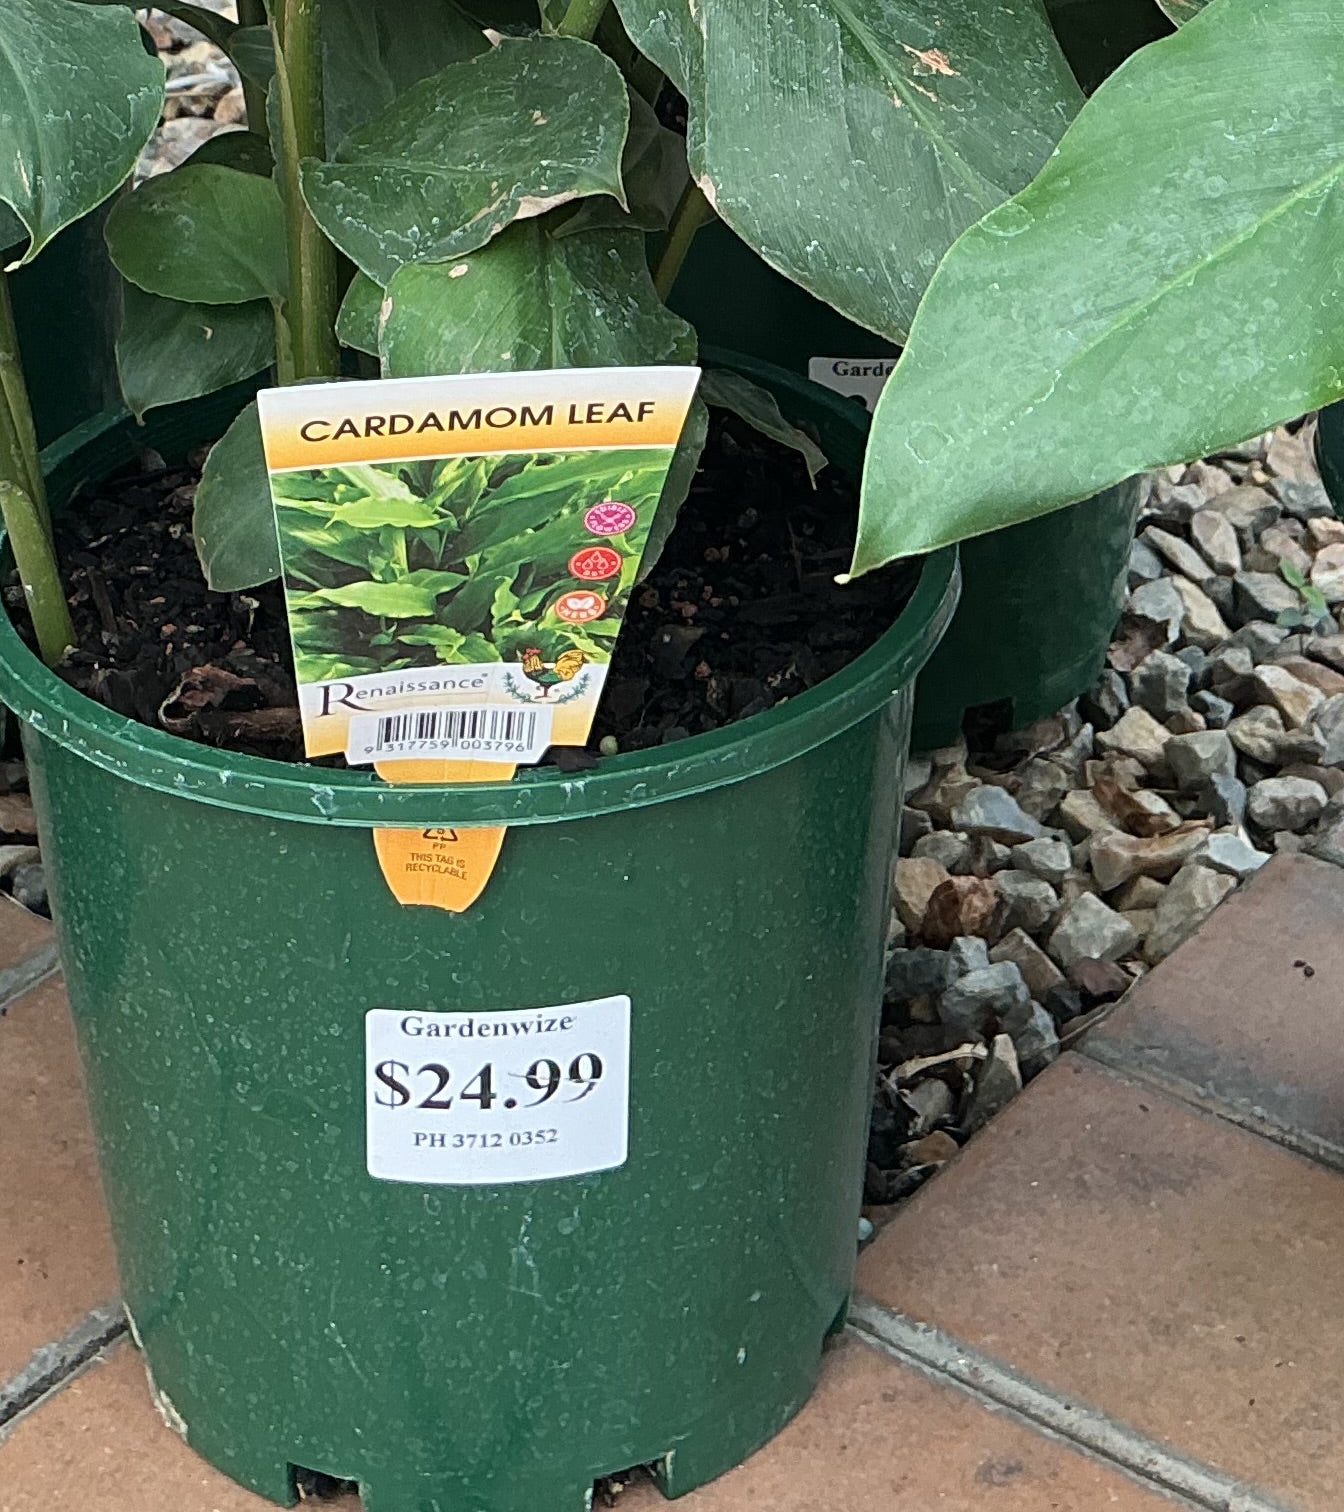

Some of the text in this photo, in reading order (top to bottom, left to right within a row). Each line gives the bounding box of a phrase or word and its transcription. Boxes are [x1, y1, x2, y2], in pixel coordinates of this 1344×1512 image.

[300, 402, 655, 442] CARDAMOM LEAF
[315, 676, 485, 718] Renaissance
[405, 862, 468, 881] RECYCLABLE
[410, 852, 433, 863] THIS
[435, 853, 454, 866] TAG
[400, 1013, 576, 1038] Gardenwize
[374, 1052, 603, 1110] $24.99
[413, 1128, 558, 1149] PH 3712 0352
